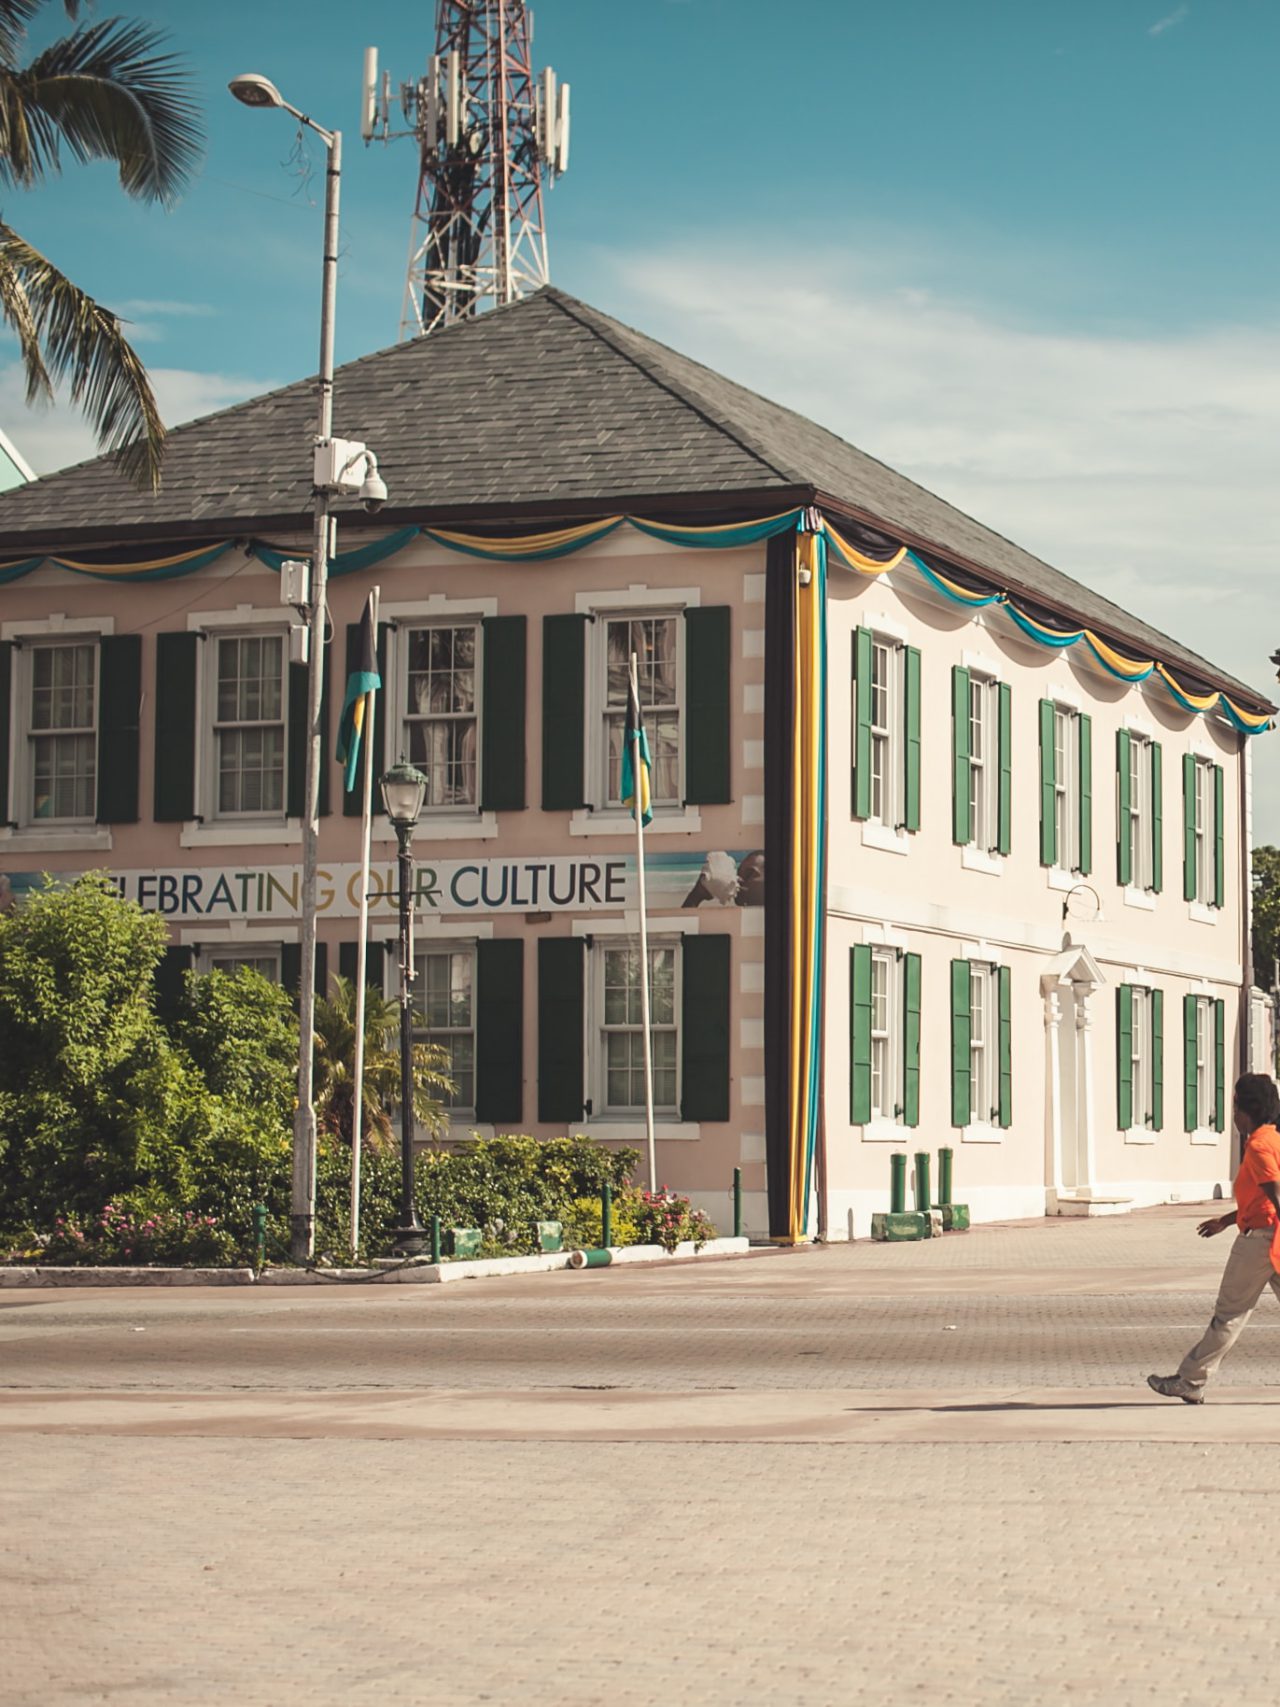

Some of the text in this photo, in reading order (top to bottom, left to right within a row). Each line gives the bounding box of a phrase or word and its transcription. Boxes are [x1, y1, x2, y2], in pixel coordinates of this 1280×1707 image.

[72, 862, 626, 915] EBRATING OUR CULTURE
